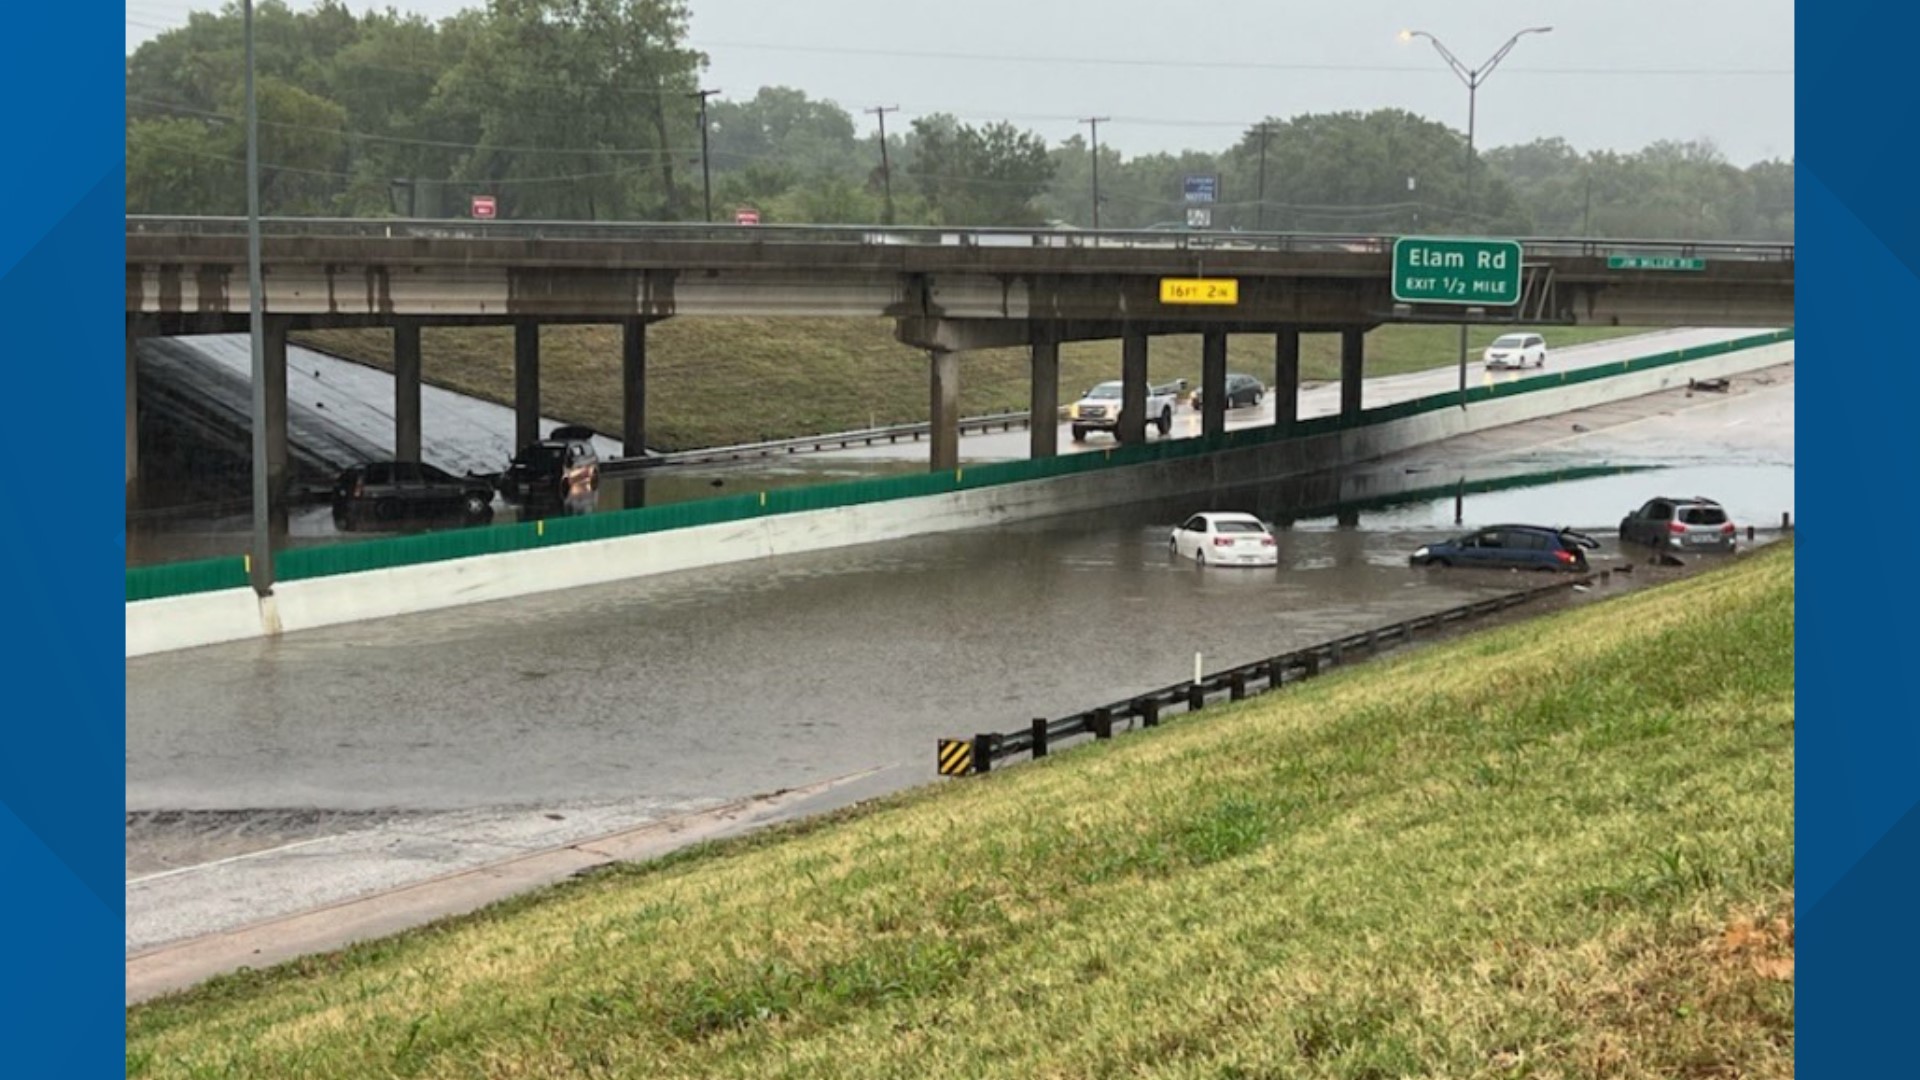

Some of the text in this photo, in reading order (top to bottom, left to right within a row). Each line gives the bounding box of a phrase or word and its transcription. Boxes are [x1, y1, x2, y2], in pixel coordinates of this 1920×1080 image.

[1409, 248, 1506, 270] Elam Rd
[1406, 277, 1436, 290] EXIT
[1473, 280, 1506, 294] MILE
